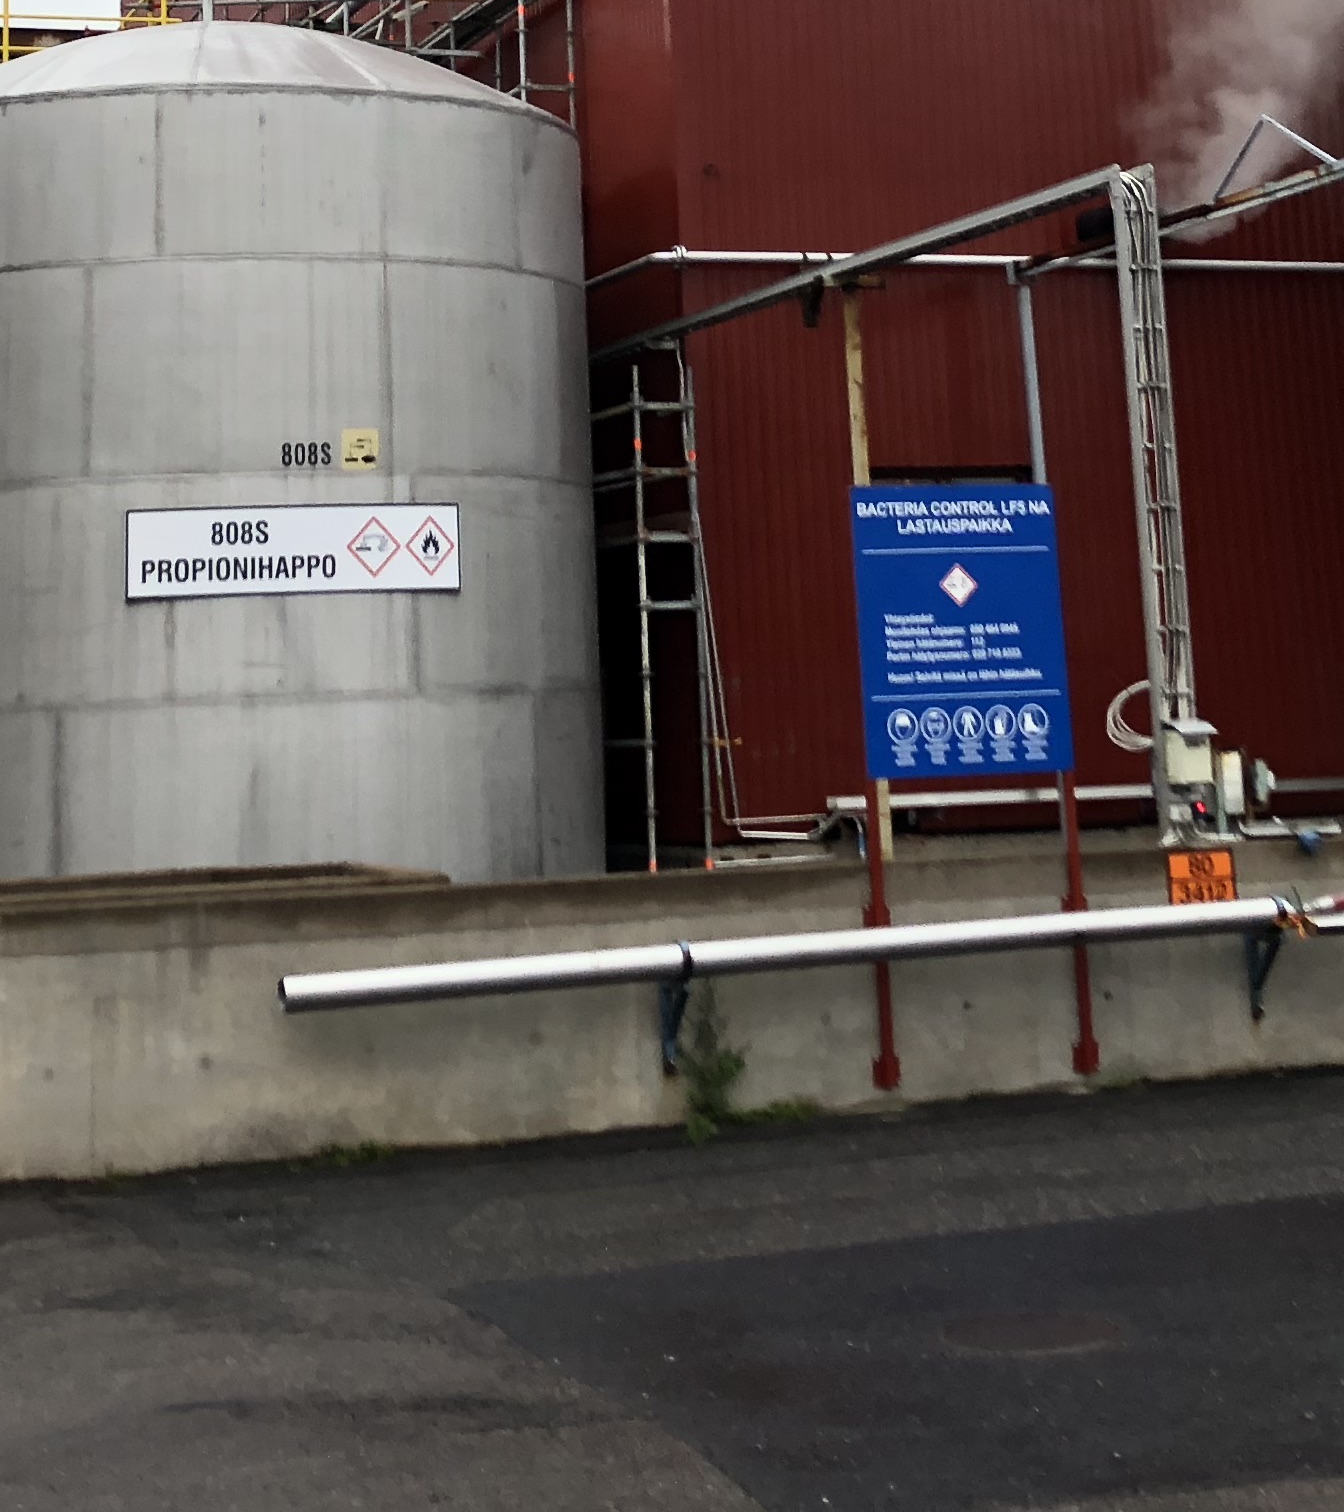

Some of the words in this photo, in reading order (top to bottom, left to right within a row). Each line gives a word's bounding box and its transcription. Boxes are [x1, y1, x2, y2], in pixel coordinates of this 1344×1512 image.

[281, 442, 331, 466] 808S
[856, 501, 928, 518] BACTERIA
[930, 501, 998, 517] CONTROL
[1028, 500, 1051, 516] NA
[211, 520, 269, 545] 808S
[896, 517, 1014, 536] LASTAUSPAIKKA
[141, 554, 337, 584] PROPIONIHAPPO
